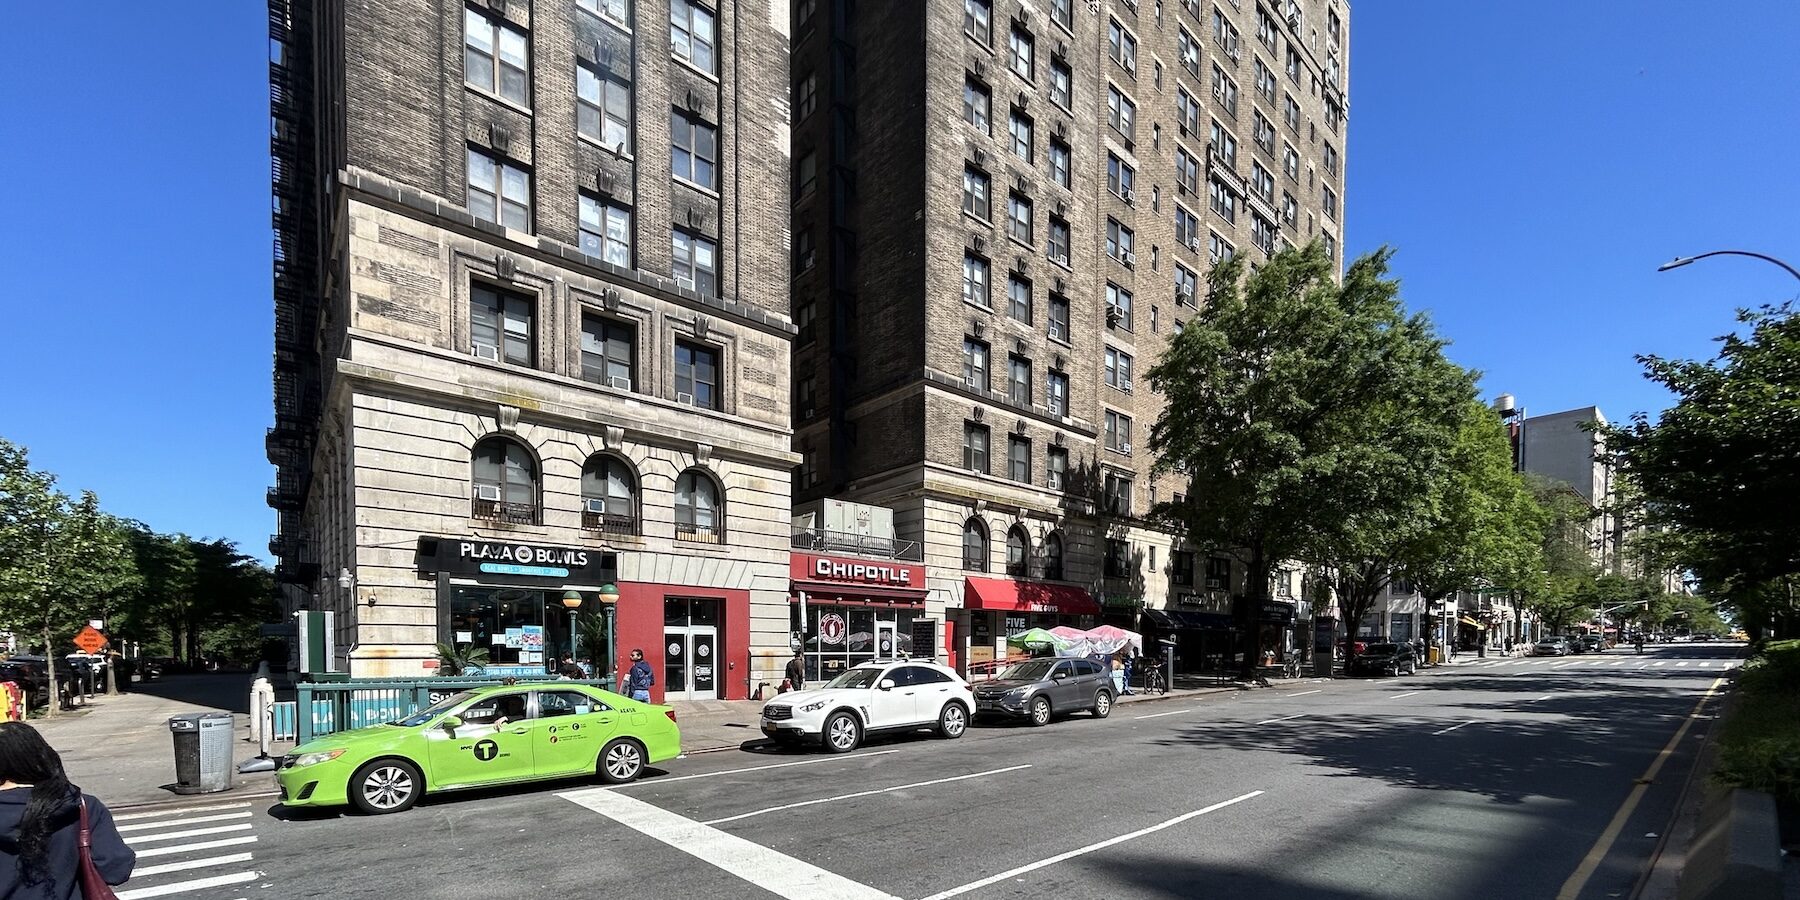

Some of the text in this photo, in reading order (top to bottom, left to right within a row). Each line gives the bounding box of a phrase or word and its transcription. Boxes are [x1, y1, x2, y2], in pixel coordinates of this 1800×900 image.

[460, 542, 588, 566] PLAYA BOWLS
[816, 558, 911, 582] CHIPOTLE
[1030, 604, 1059, 613] FIVE GUYS
[1005, 617, 1026, 628] FIVE
[429, 692, 454, 704] Su
[478, 742, 494, 759] T
